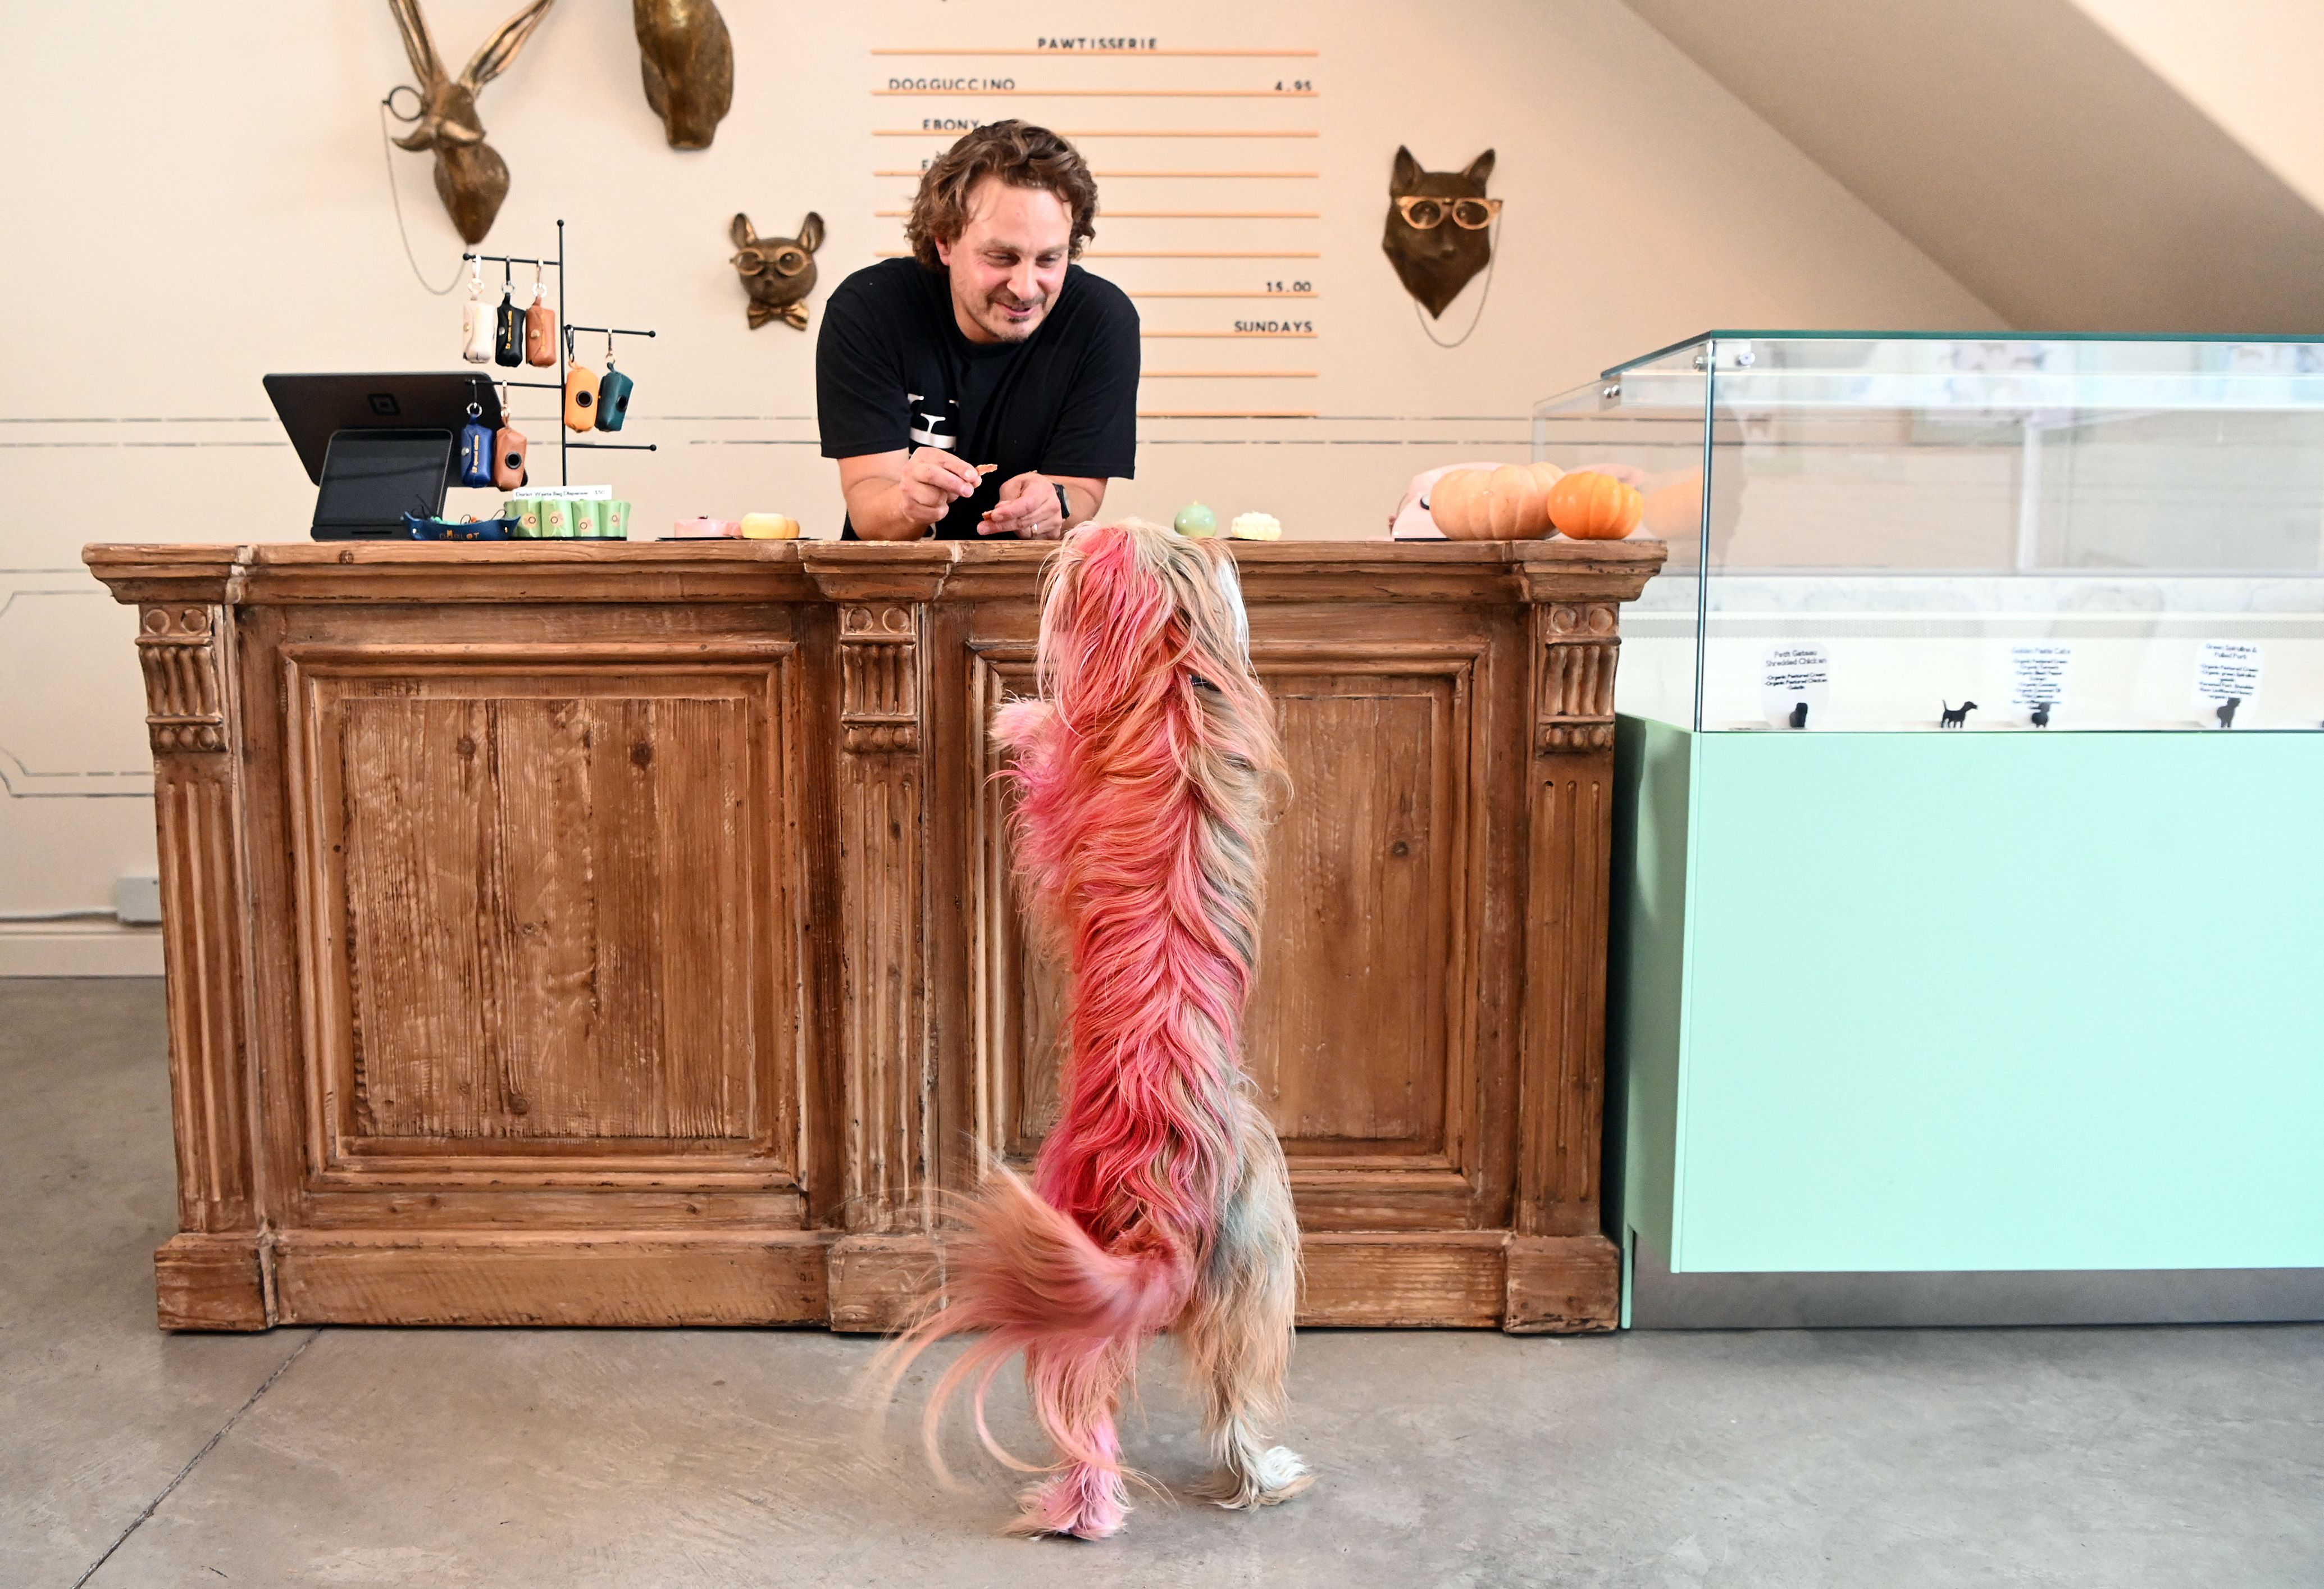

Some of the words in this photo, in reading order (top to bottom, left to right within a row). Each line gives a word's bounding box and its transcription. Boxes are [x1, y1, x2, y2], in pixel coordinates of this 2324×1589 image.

[1038, 38, 1156, 49] PAWTISSERIE
[889, 78, 1015, 90] DOGGUCCINO
[1275, 80, 1312, 91] 4.95
[923, 119, 979, 130] EBONY
[1266, 281, 1311, 292] 15.00
[1234, 321, 1313, 333] SUNDAYS
